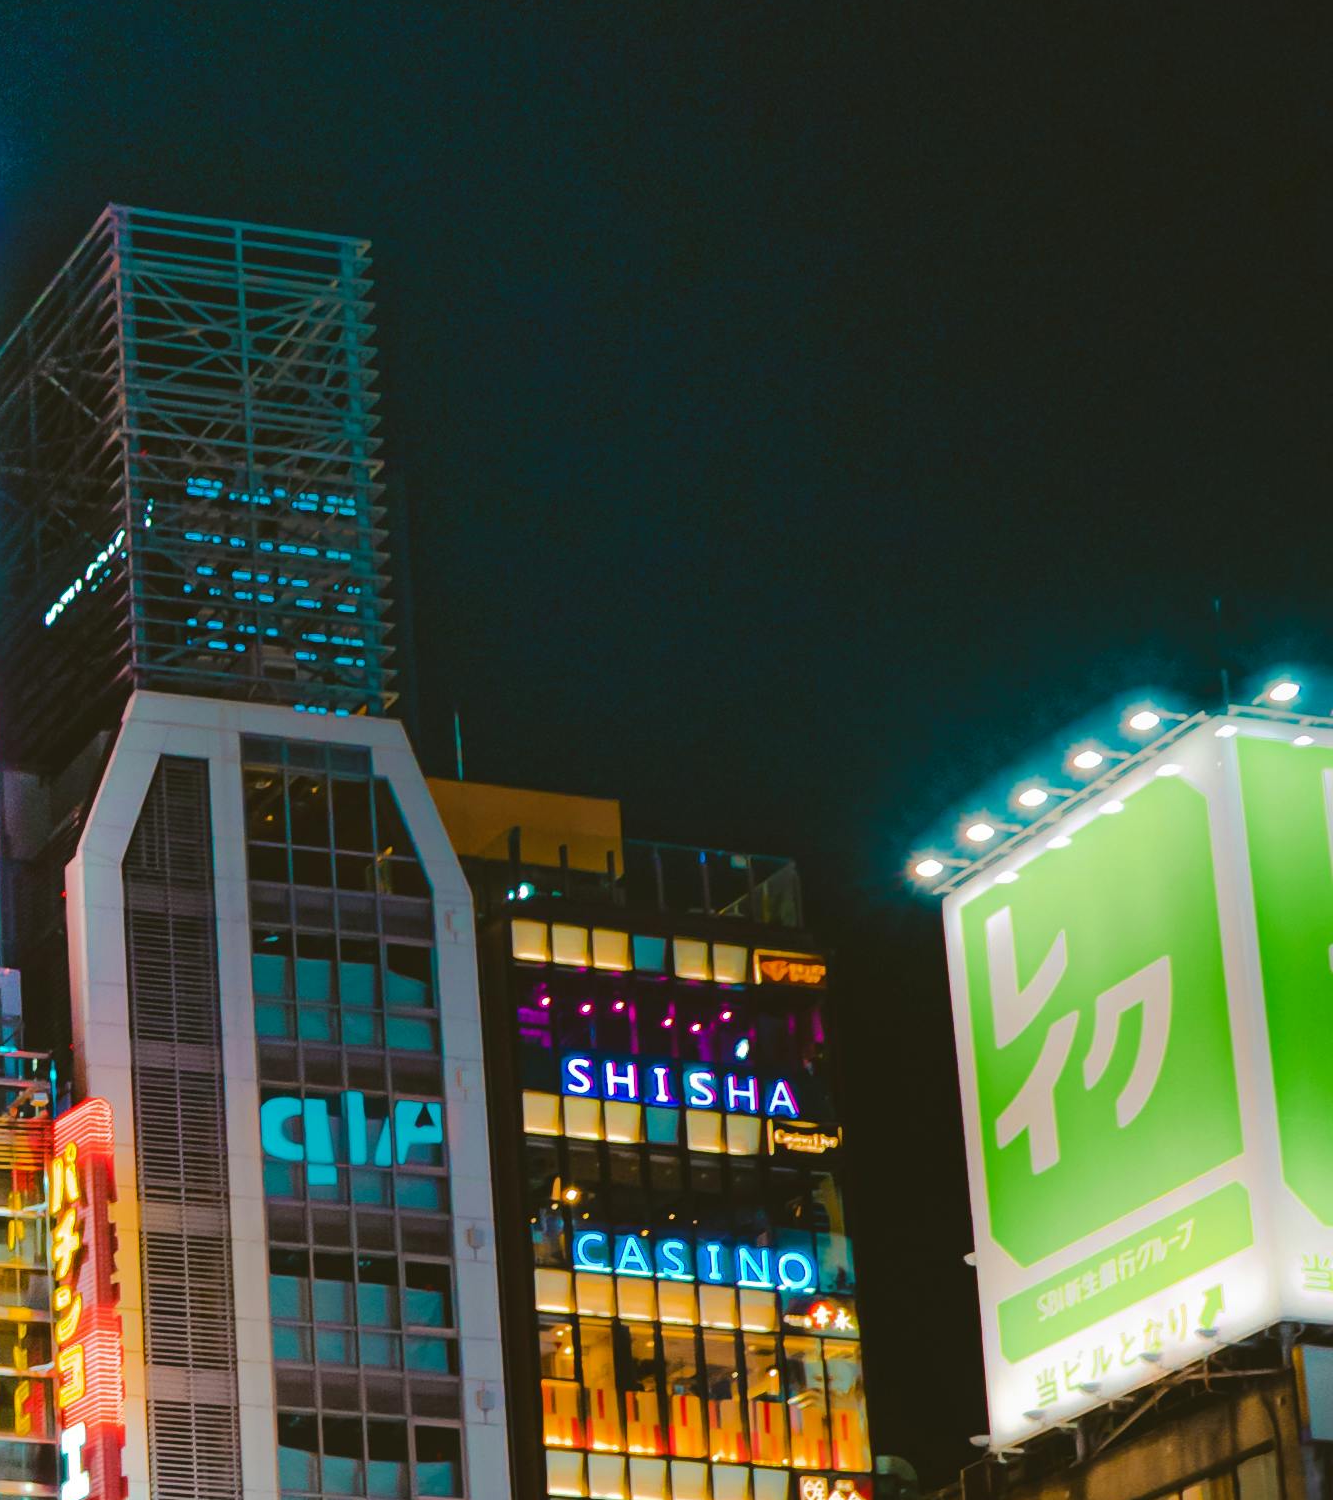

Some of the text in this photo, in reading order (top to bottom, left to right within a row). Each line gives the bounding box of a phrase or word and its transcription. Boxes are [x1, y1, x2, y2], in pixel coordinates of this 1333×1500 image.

[566, 1057, 800, 1118] SHISHA
[984, 906, 1172, 1176] レイク
[50, 1142, 86, 1408] パチンコ
[576, 1232, 815, 1291] CASINO
[1036, 1303, 1188, 1407] 当ビルとなり
